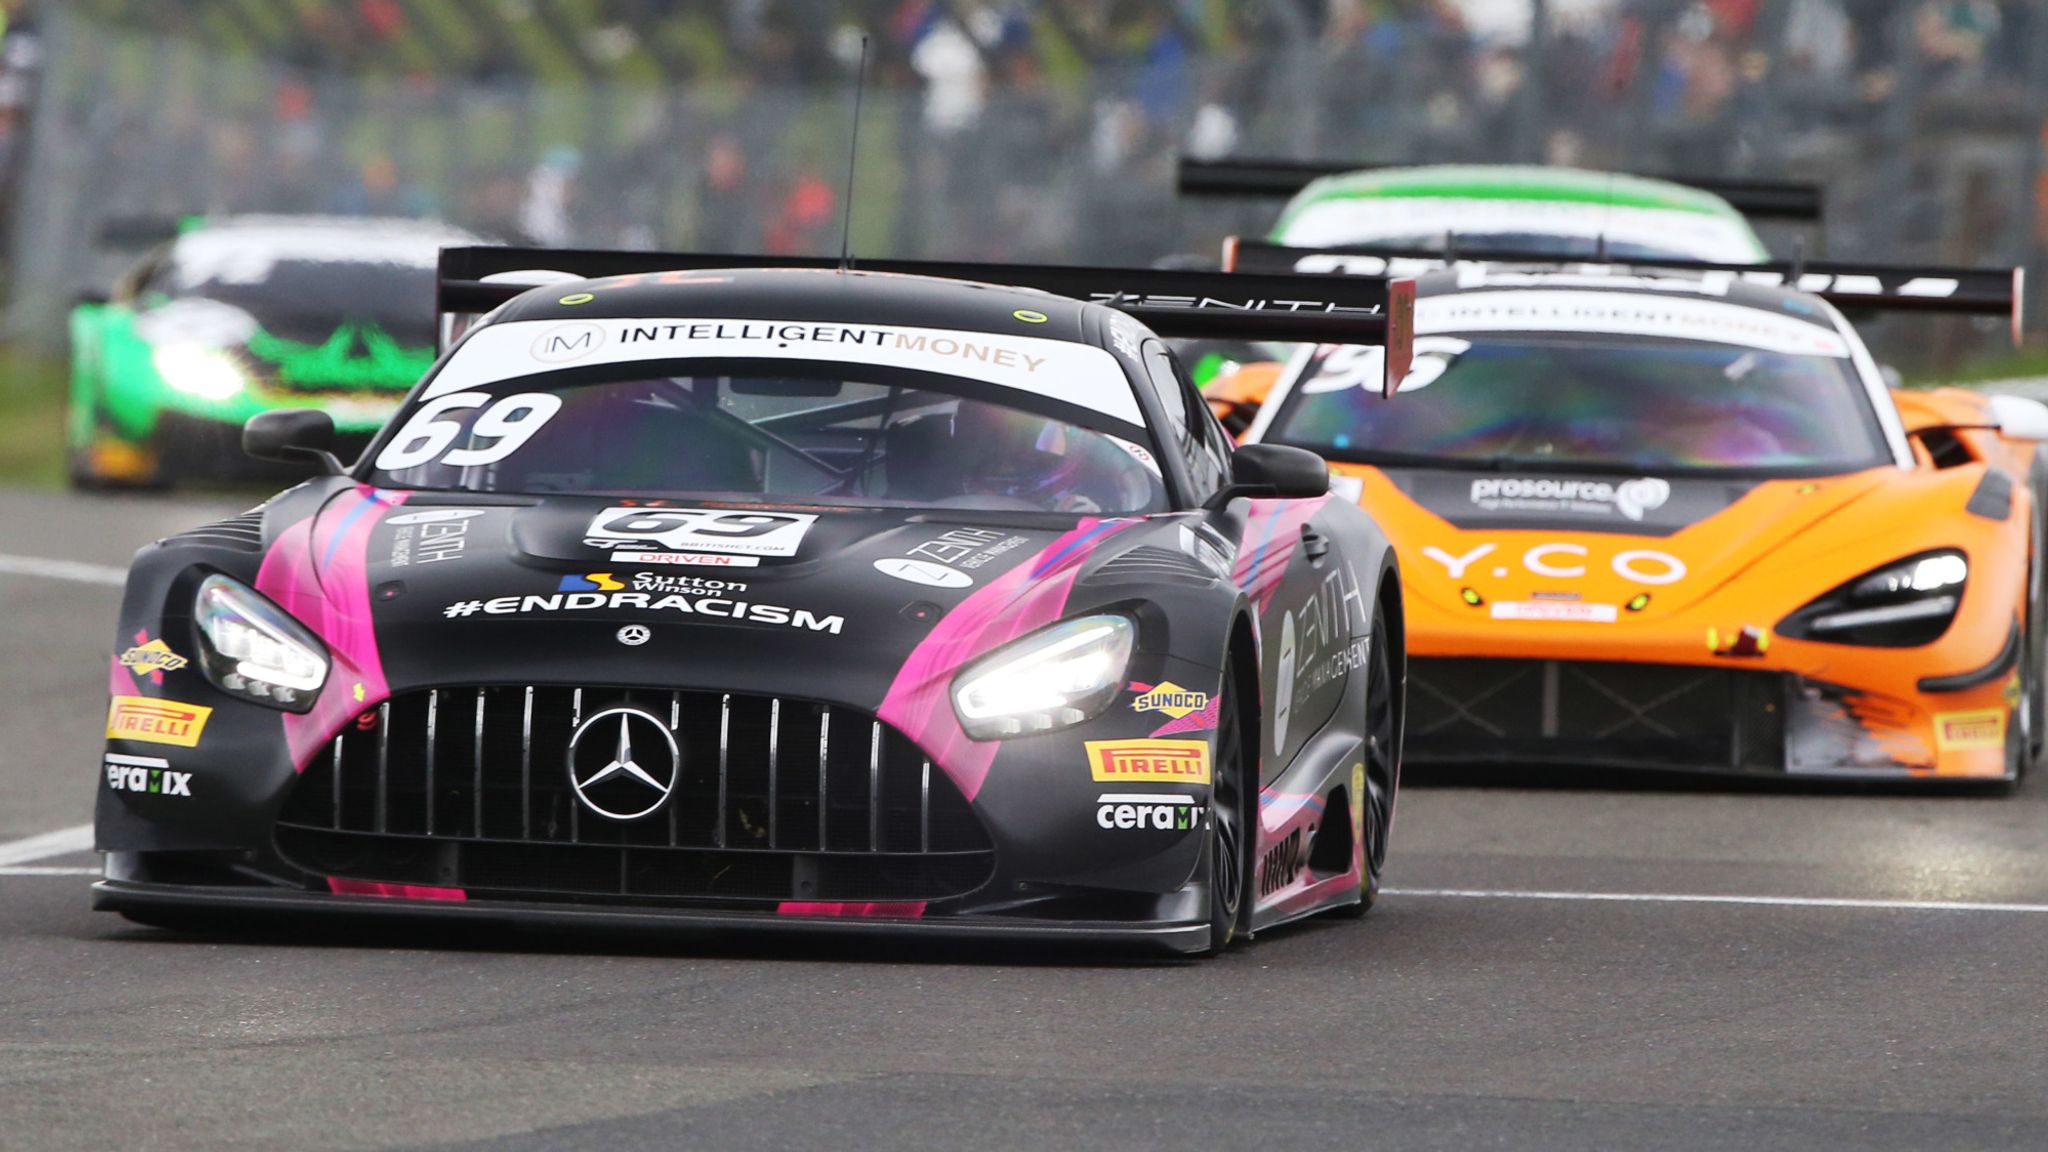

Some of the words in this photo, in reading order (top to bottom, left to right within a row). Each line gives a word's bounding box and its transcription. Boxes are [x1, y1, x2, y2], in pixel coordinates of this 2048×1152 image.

[375, 392, 563, 471] 69
[1470, 478, 1614, 503] prosource
[602, 510, 800, 538] 69
[640, 552, 731, 565] DRIVEN
[1421, 542, 1687, 584] Y.CO
[632, 580, 722, 597] Winson
[634, 571, 748, 592] Sutton
[443, 592, 845, 634] #ENDRACISM
[1137, 693, 1204, 710] SUNOCO
[112, 704, 196, 737] PIRELLI
[1100, 747, 1203, 776] PIRELLI
